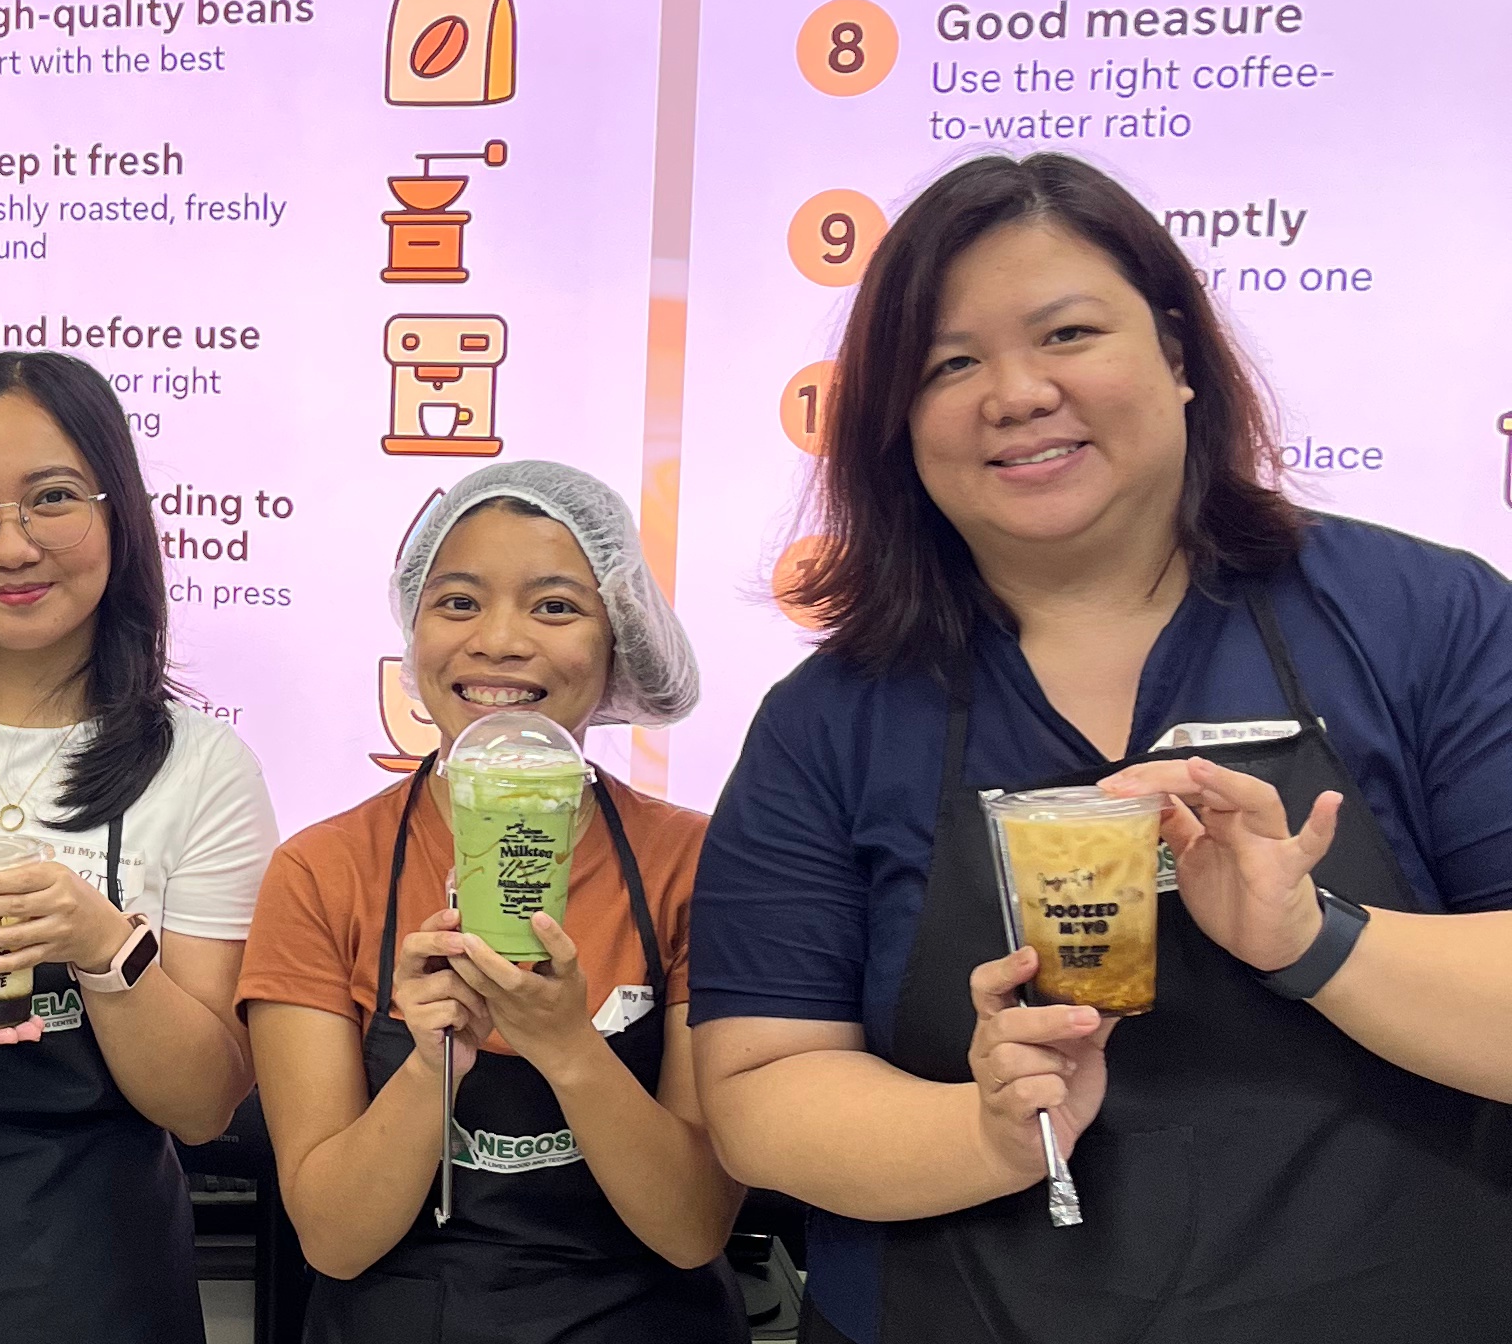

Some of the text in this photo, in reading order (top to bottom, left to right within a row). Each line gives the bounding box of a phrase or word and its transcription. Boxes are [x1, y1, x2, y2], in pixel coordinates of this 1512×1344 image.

[936, 2, 1304, 43] Good measure
[30, 46, 94, 75] with
[102, 46, 152, 74] the
[160, 44, 226, 73] best
[826, 22, 866, 74] 8
[930, 55, 1335, 99] Use the right coffee-
[929, 107, 1192, 141] to-water ratio
[54, 145, 77, 177] it
[88, 142, 184, 177] fresh
[59, 194, 176, 226] roasted,
[184, 192, 287, 227] freshly
[820, 212, 856, 266] 9
[1239, 268, 1287, 291] no
[1299, 268, 1373, 291] one
[61, 315, 183, 349] before
[194, 324, 261, 350] use
[153, 366, 222, 400] right
[255, 490, 295, 519] to
[214, 584, 292, 610] press
